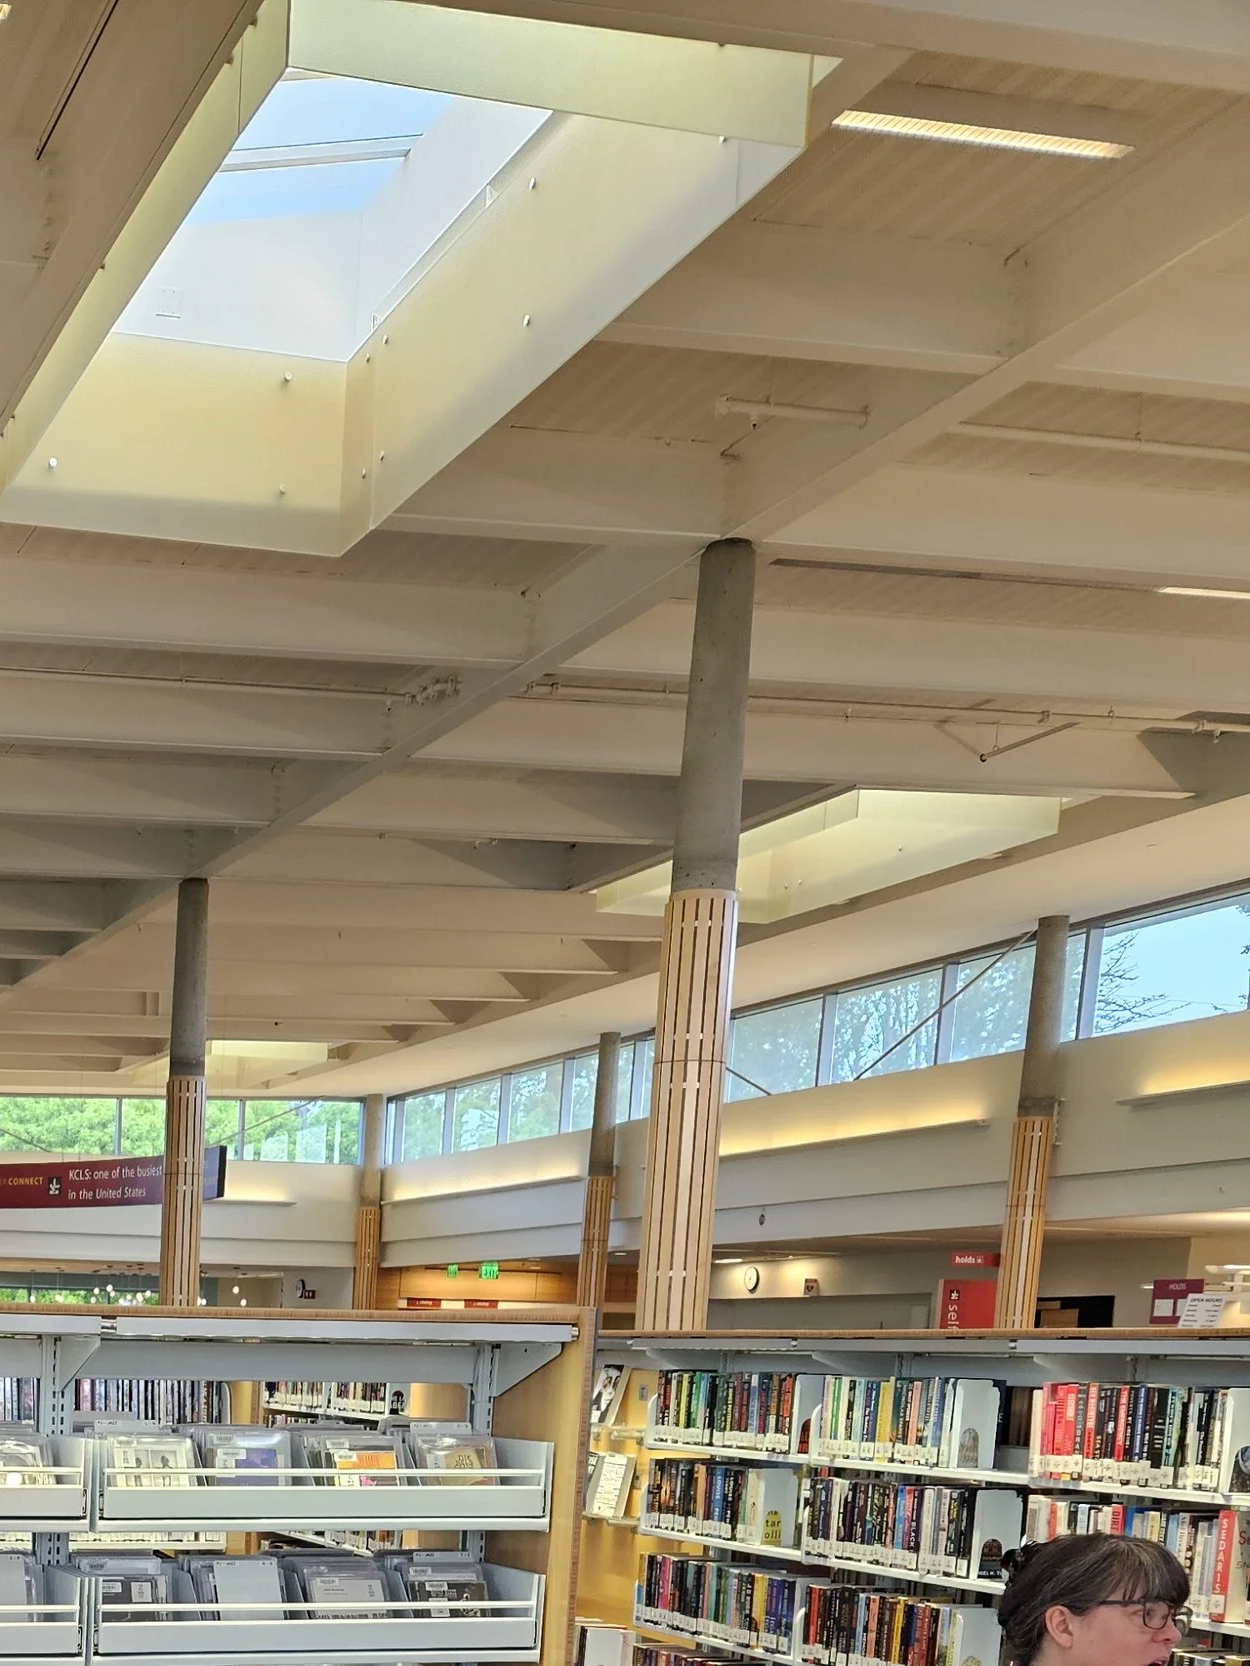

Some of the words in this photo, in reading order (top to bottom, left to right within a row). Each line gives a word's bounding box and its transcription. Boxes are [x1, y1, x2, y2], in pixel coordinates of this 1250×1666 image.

[69, 1168, 92, 1180] KCLS:
[93, 1169, 109, 1179] one
[110, 1167, 121, 1179] of
[122, 1166, 136, 1178] the
[137, 1165, 163, 1177] busiest
[8, 1176, 43, 1186] CONNECT
[68, 1189, 77, 1200] in
[79, 1188, 94, 1200] the
[97, 1187, 122, 1199] United
[124, 1186, 147, 1198] States
[955, 1255, 975, 1264] holds
[1110, 1510, 1121, 1534] DIRT
[1213, 1518, 1229, 1594] SEDARIS
